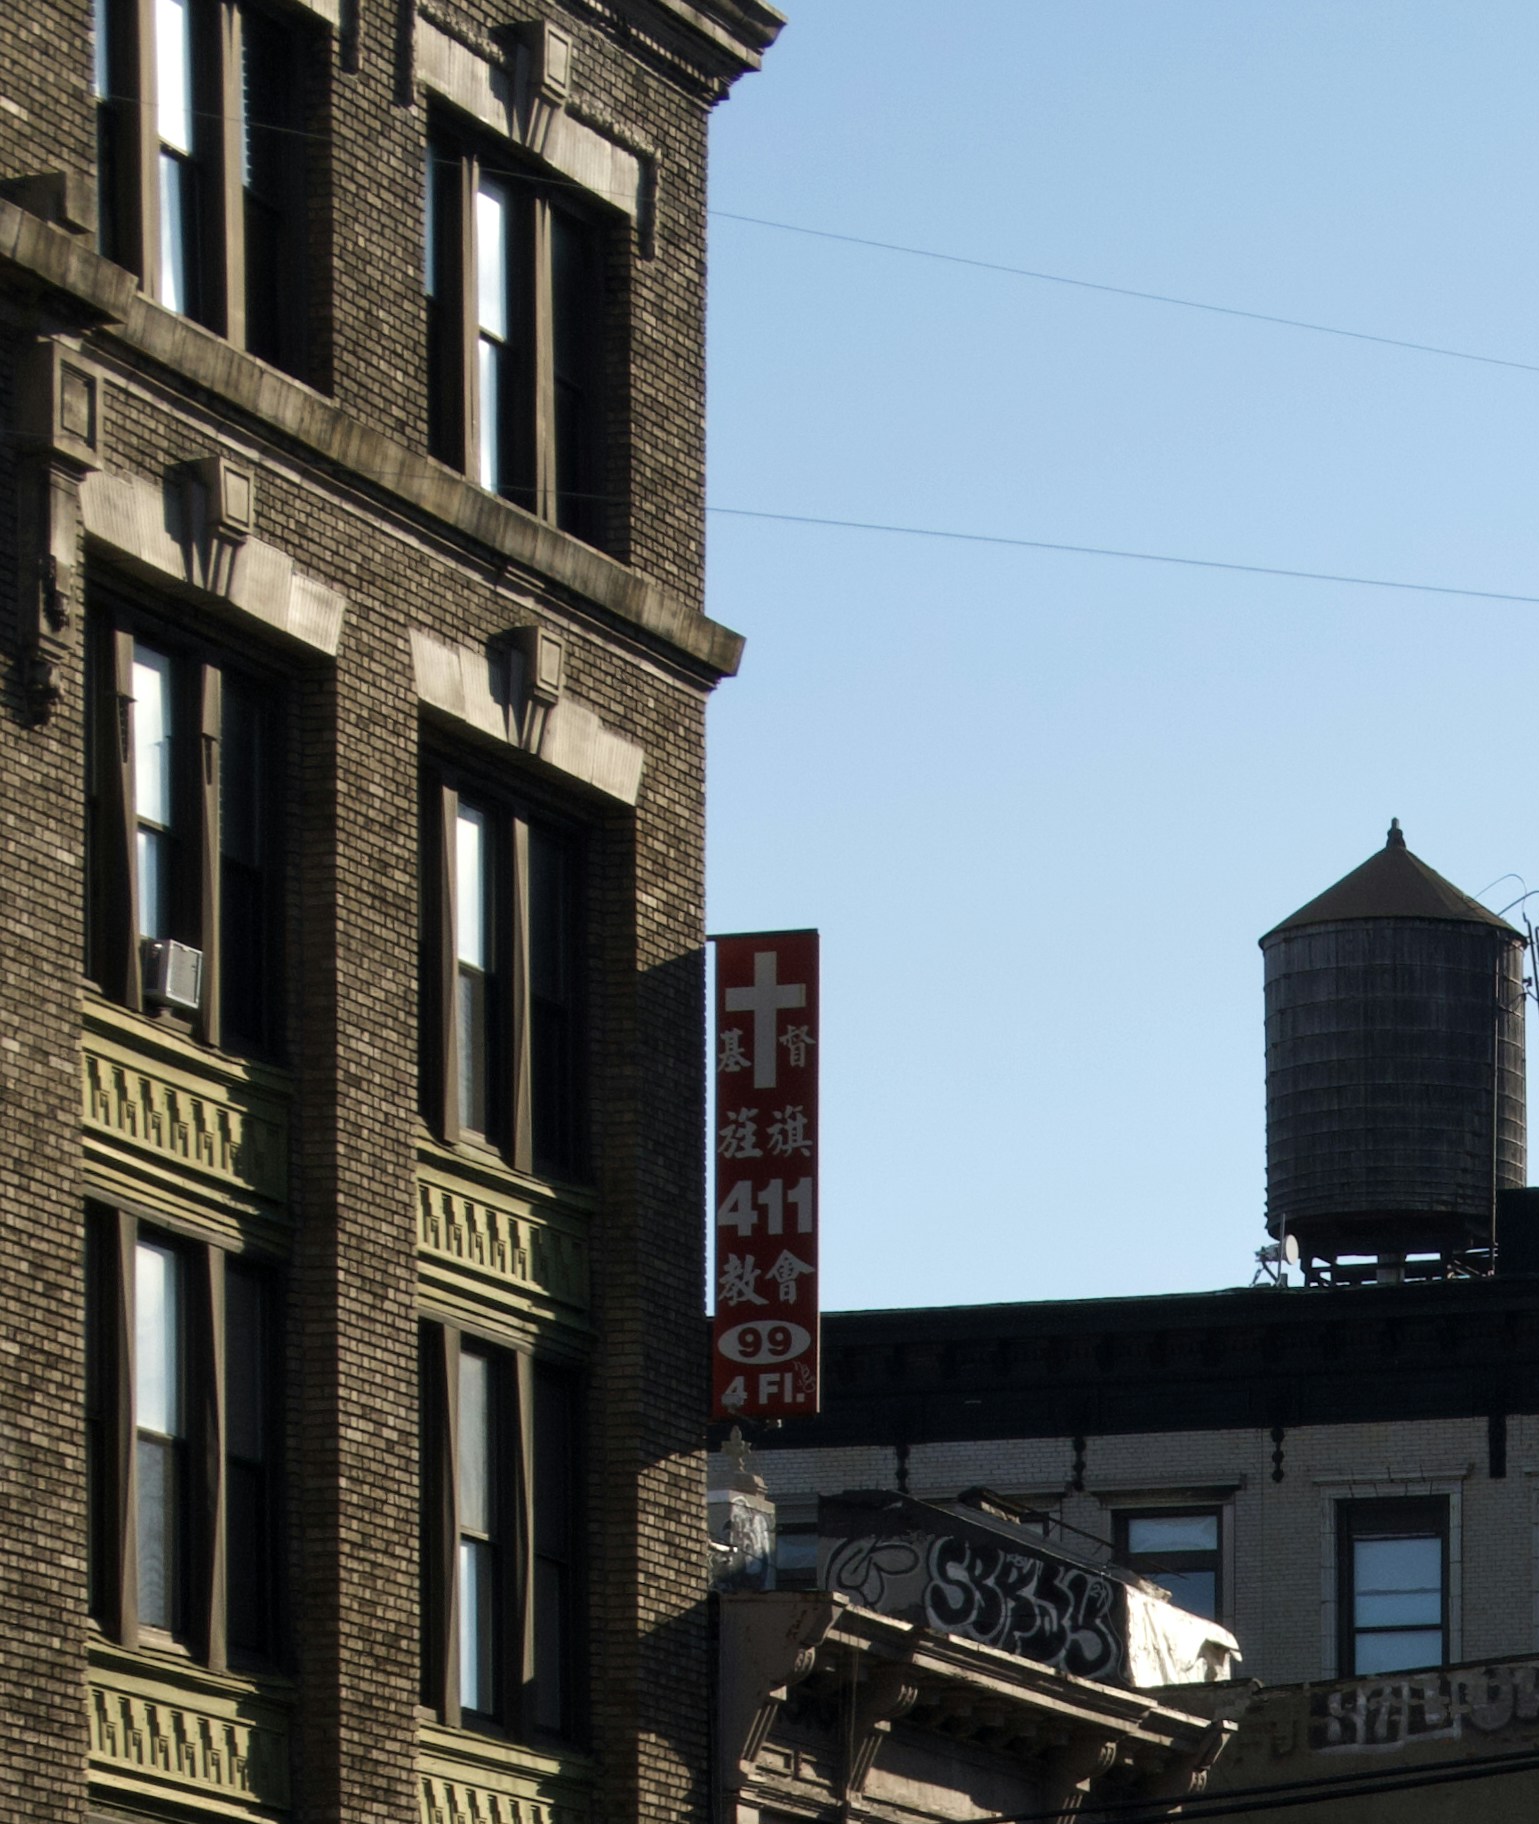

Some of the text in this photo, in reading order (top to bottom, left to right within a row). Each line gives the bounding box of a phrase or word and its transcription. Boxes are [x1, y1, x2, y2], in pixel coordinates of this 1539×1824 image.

[718, 1177, 813, 1237] 411
[718, 1249, 815, 1307] 教會
[737, 1326, 792, 1357] 99
[721, 1376, 747, 1407] 4
